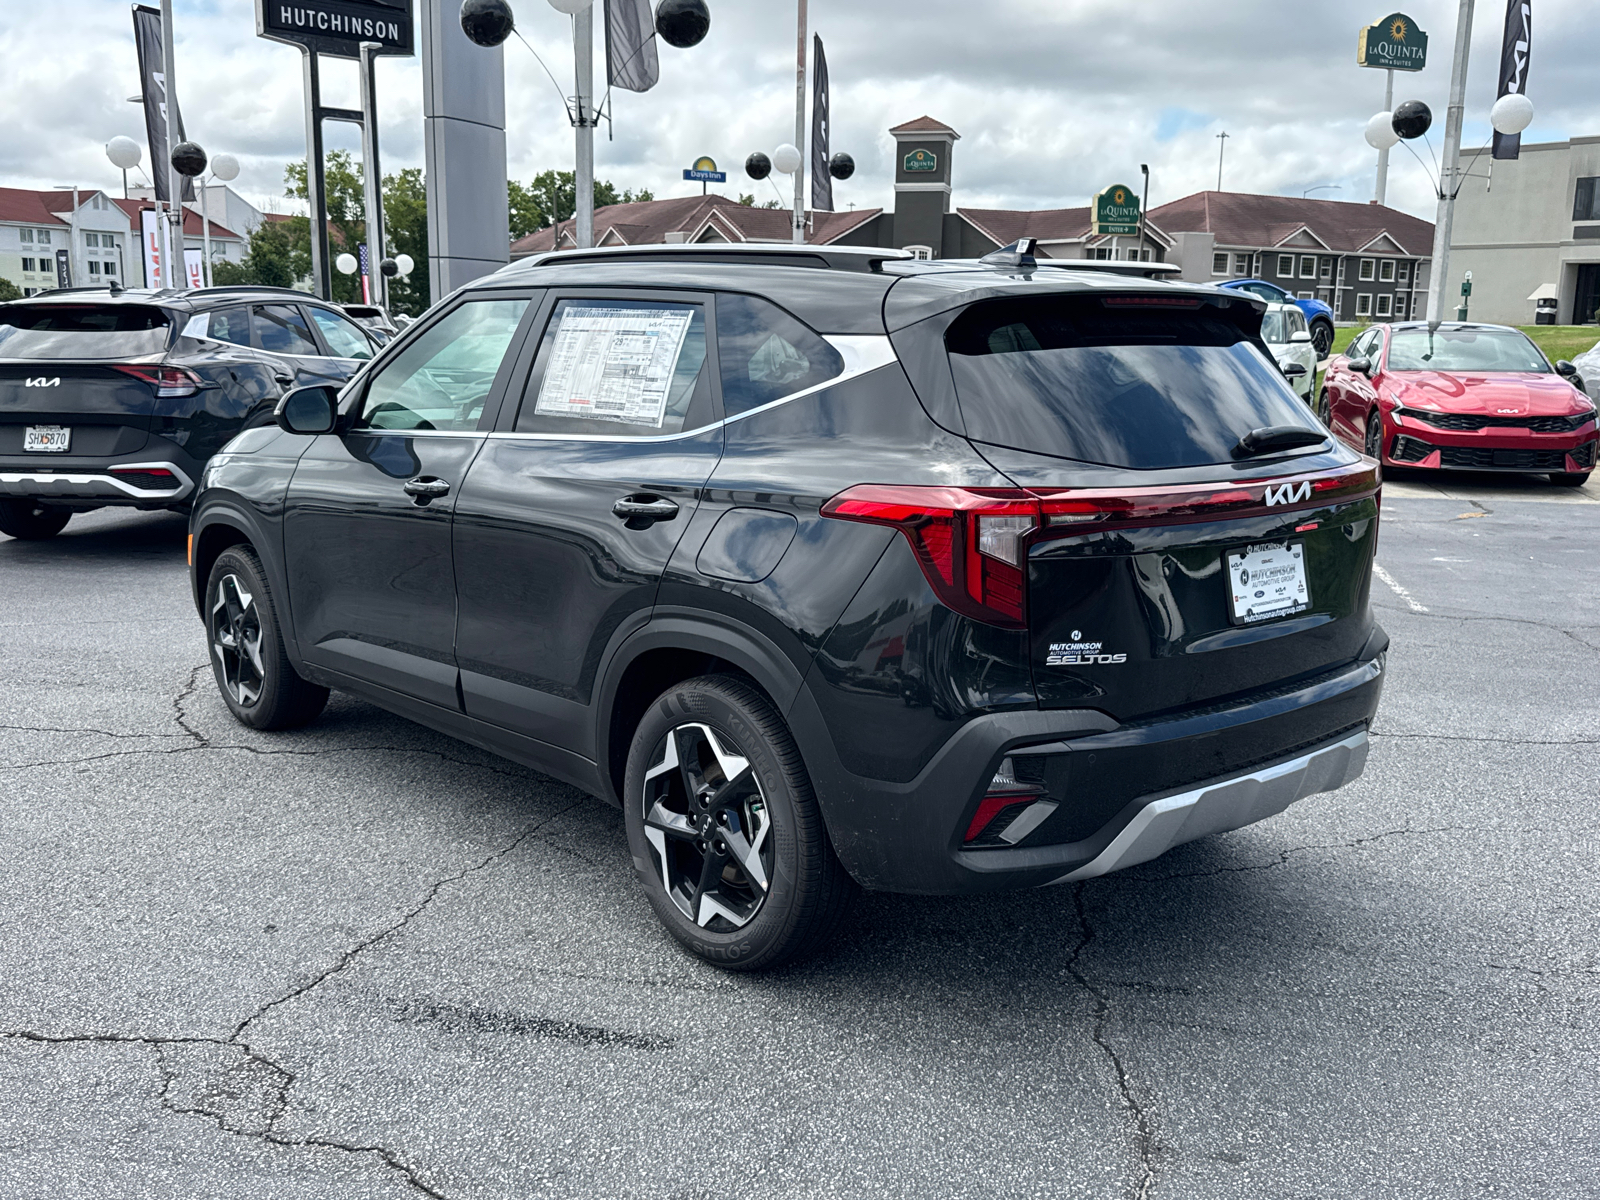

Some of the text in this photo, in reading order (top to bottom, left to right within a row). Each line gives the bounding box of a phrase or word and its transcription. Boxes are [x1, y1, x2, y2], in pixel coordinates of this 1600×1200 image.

[280, 6, 399, 41] HUTCHINSON
[690, 170, 708, 179] Days
[25, 377, 61, 388] KIA
[1265, 481, 1311, 507] KIA
[1252, 574, 1295, 588] AUTOMOTIVE GROUP
[1049, 642, 1102, 651] HUTCHINSON
[1046, 653, 1127, 666] SELTOS
